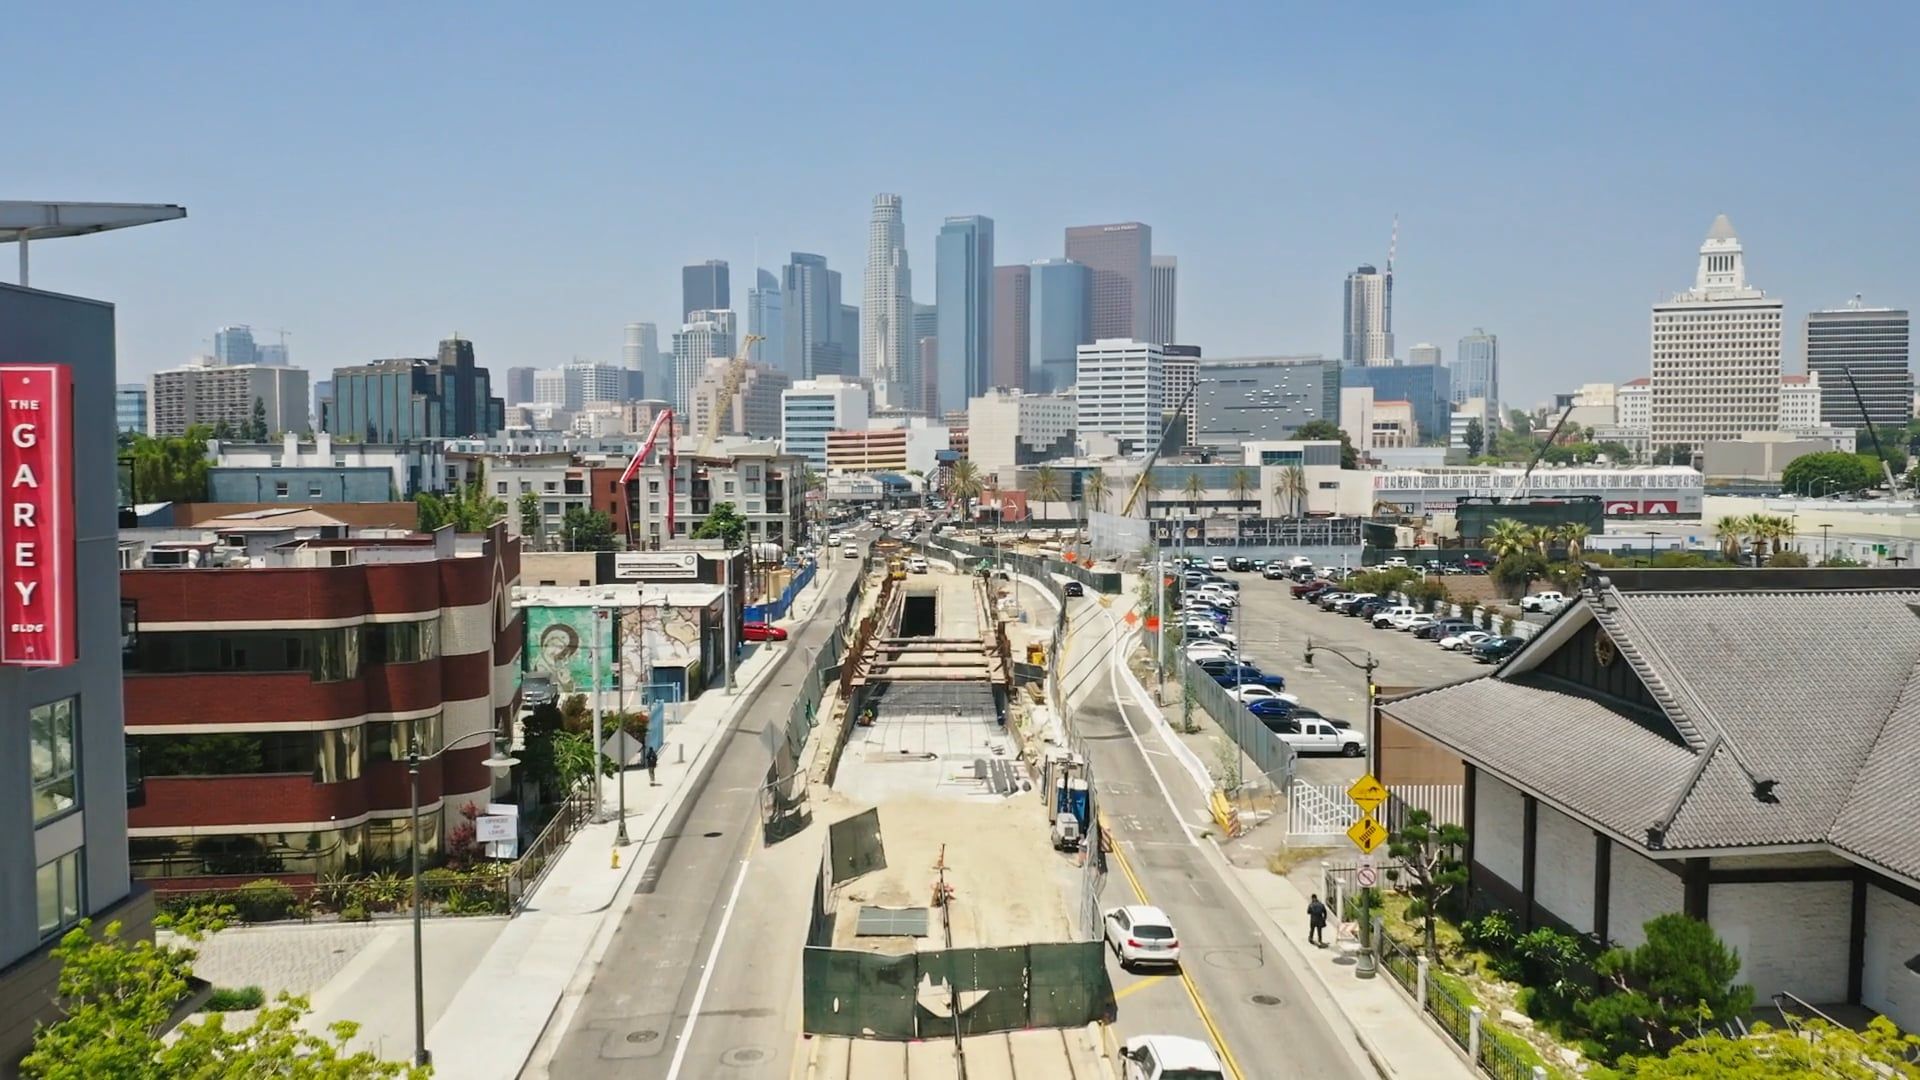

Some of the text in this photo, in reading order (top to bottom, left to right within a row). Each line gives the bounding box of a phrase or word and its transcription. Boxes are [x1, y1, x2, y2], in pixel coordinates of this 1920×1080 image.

[9, 399, 40, 410] THE
[12, 423, 38, 606] GAREY
[11, 623, 44, 633] BLDG
